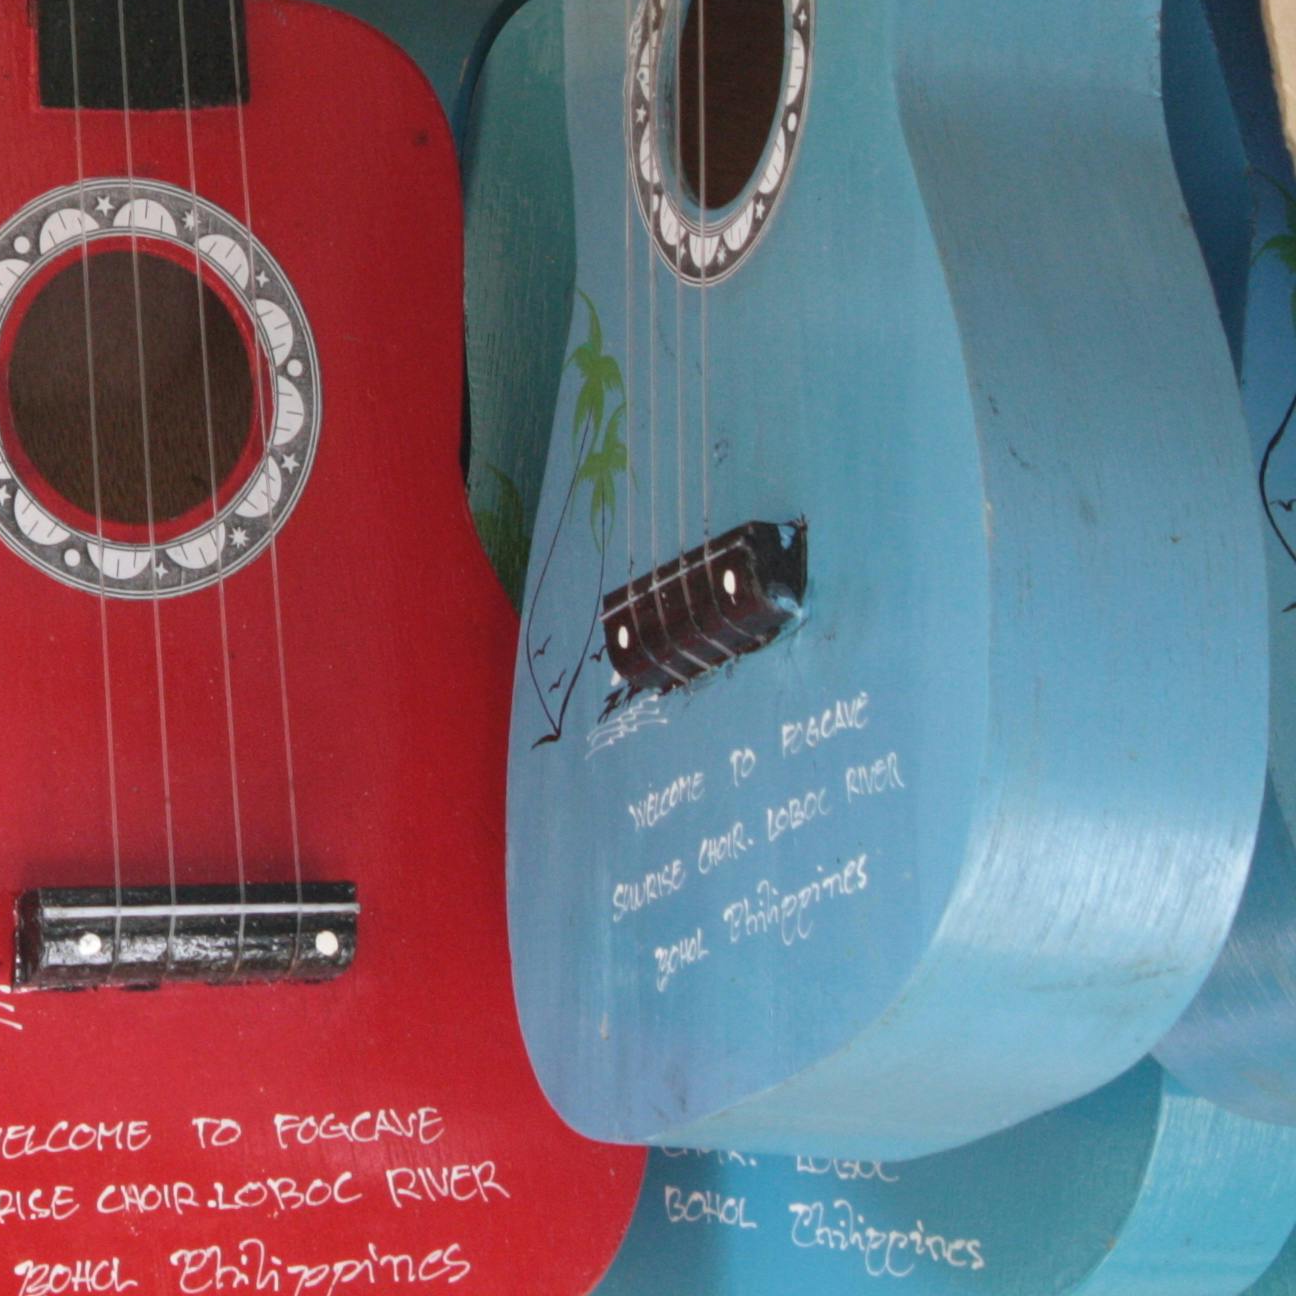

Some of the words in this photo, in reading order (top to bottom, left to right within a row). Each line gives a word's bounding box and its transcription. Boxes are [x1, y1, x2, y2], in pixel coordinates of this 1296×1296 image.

[628, 772, 705, 832] WELCOME
[730, 748, 755, 787] TO
[782, 691, 869, 755] FOGCAVE
[767, 787, 831, 841] LOBOC
[846, 752, 905, 802] RIVER
[723, 854, 868, 946] Philippines
[191, 1116, 240, 1151] TO
[273, 1106, 446, 1150] FOGCAVE
[386, 1160, 511, 1208] RIVER
[664, 1184, 758, 1229] BOHOL
[788, 1199, 985, 1277] Philippines
